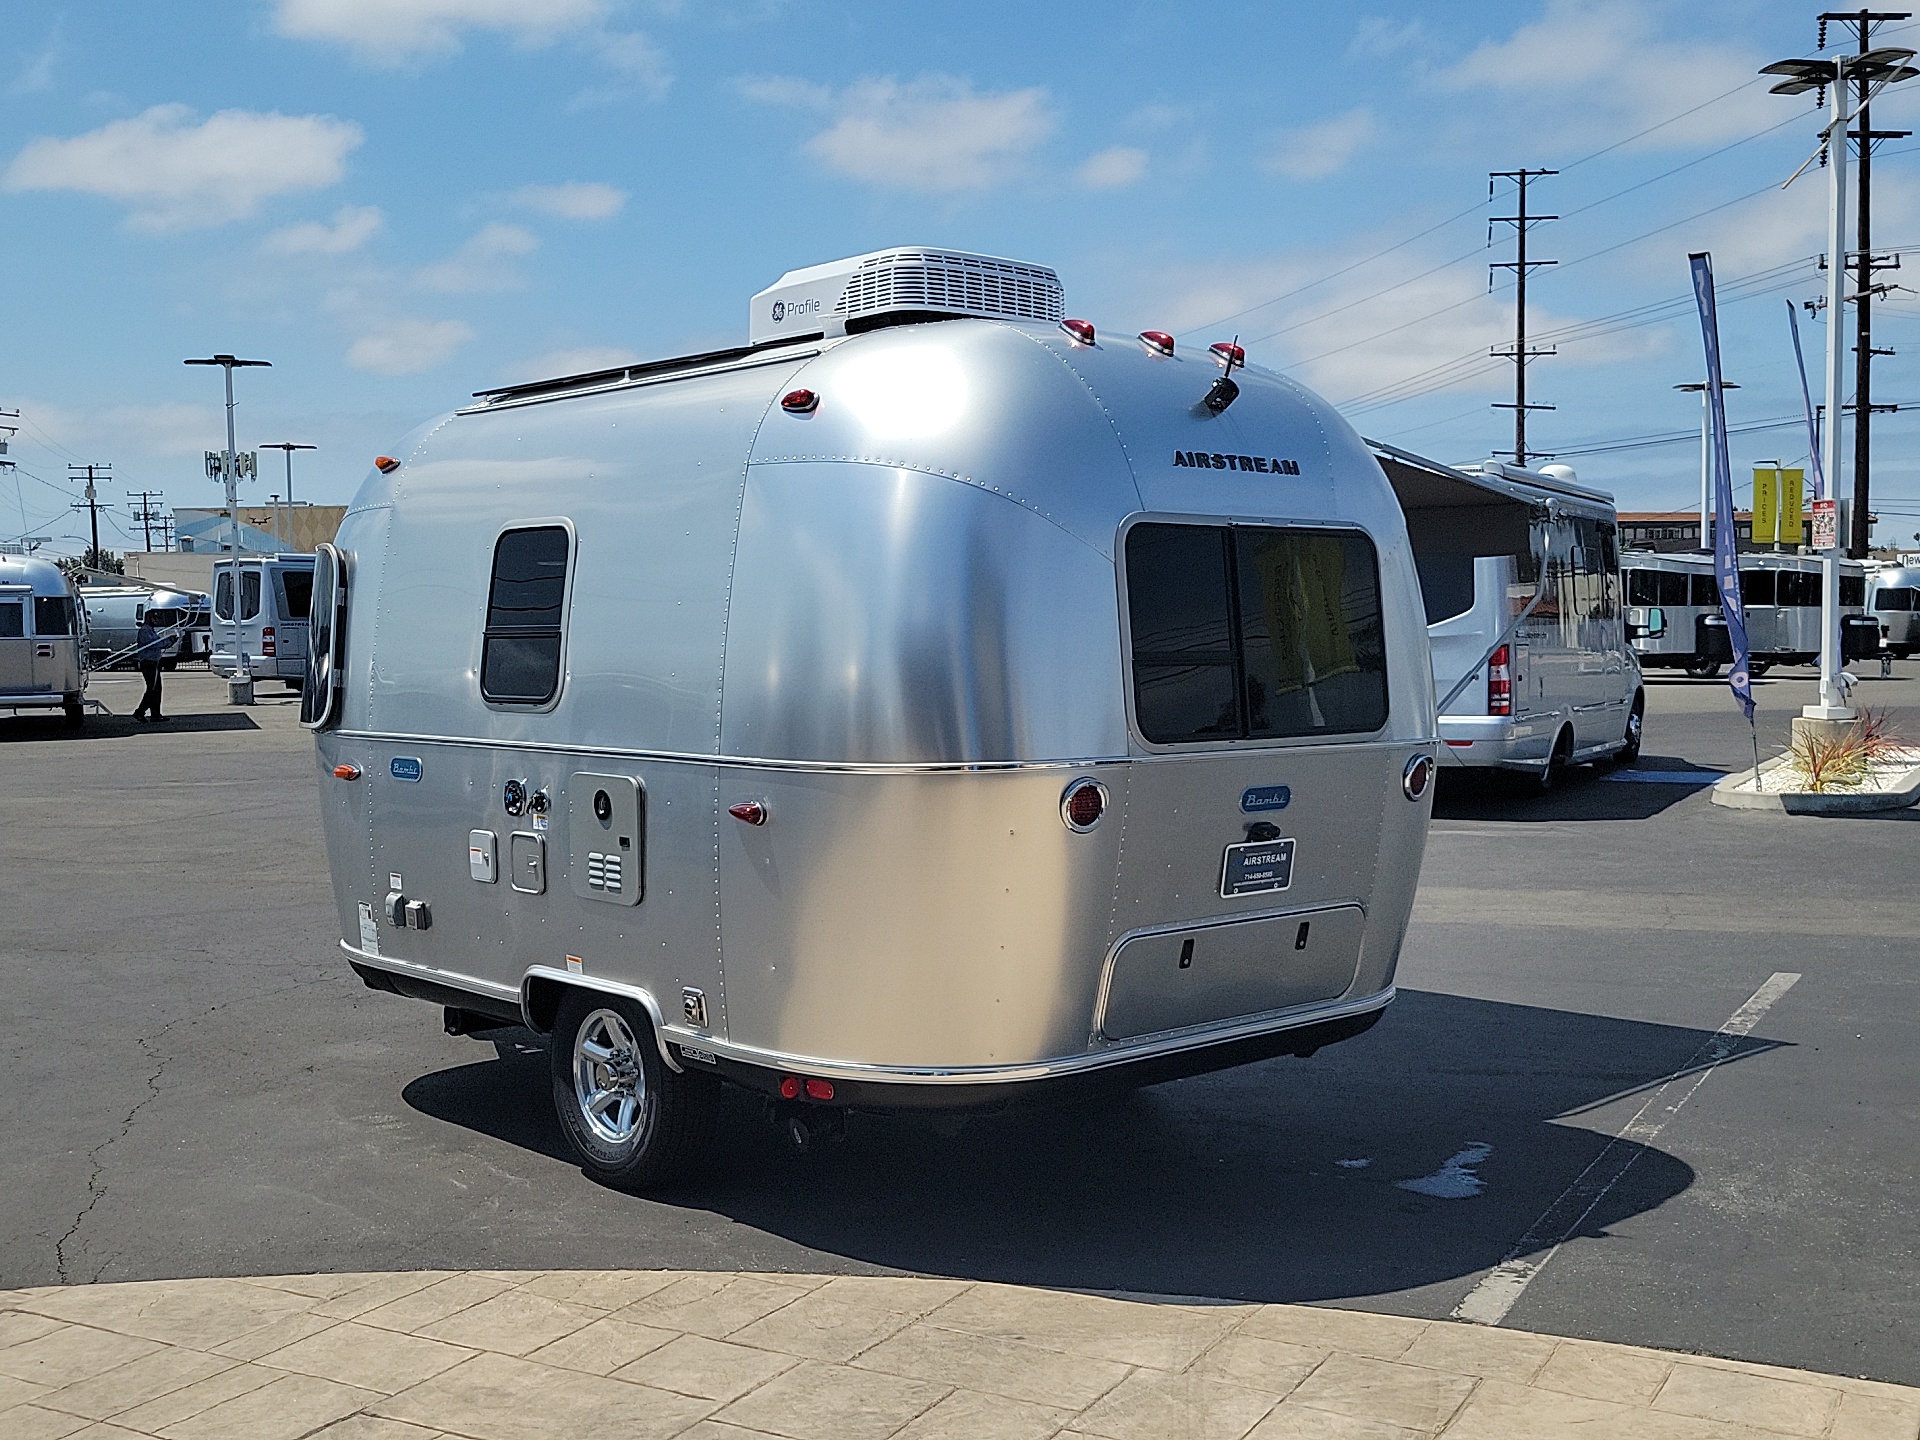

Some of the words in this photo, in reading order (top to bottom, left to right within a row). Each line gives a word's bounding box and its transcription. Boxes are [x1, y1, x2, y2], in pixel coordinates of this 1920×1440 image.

[787, 299, 820, 316] Profile
[1172, 450, 1300, 475] AIRSTREAM
[1246, 794, 1286, 806] Bambi
[1243, 853, 1287, 866] AIRSTREAM
